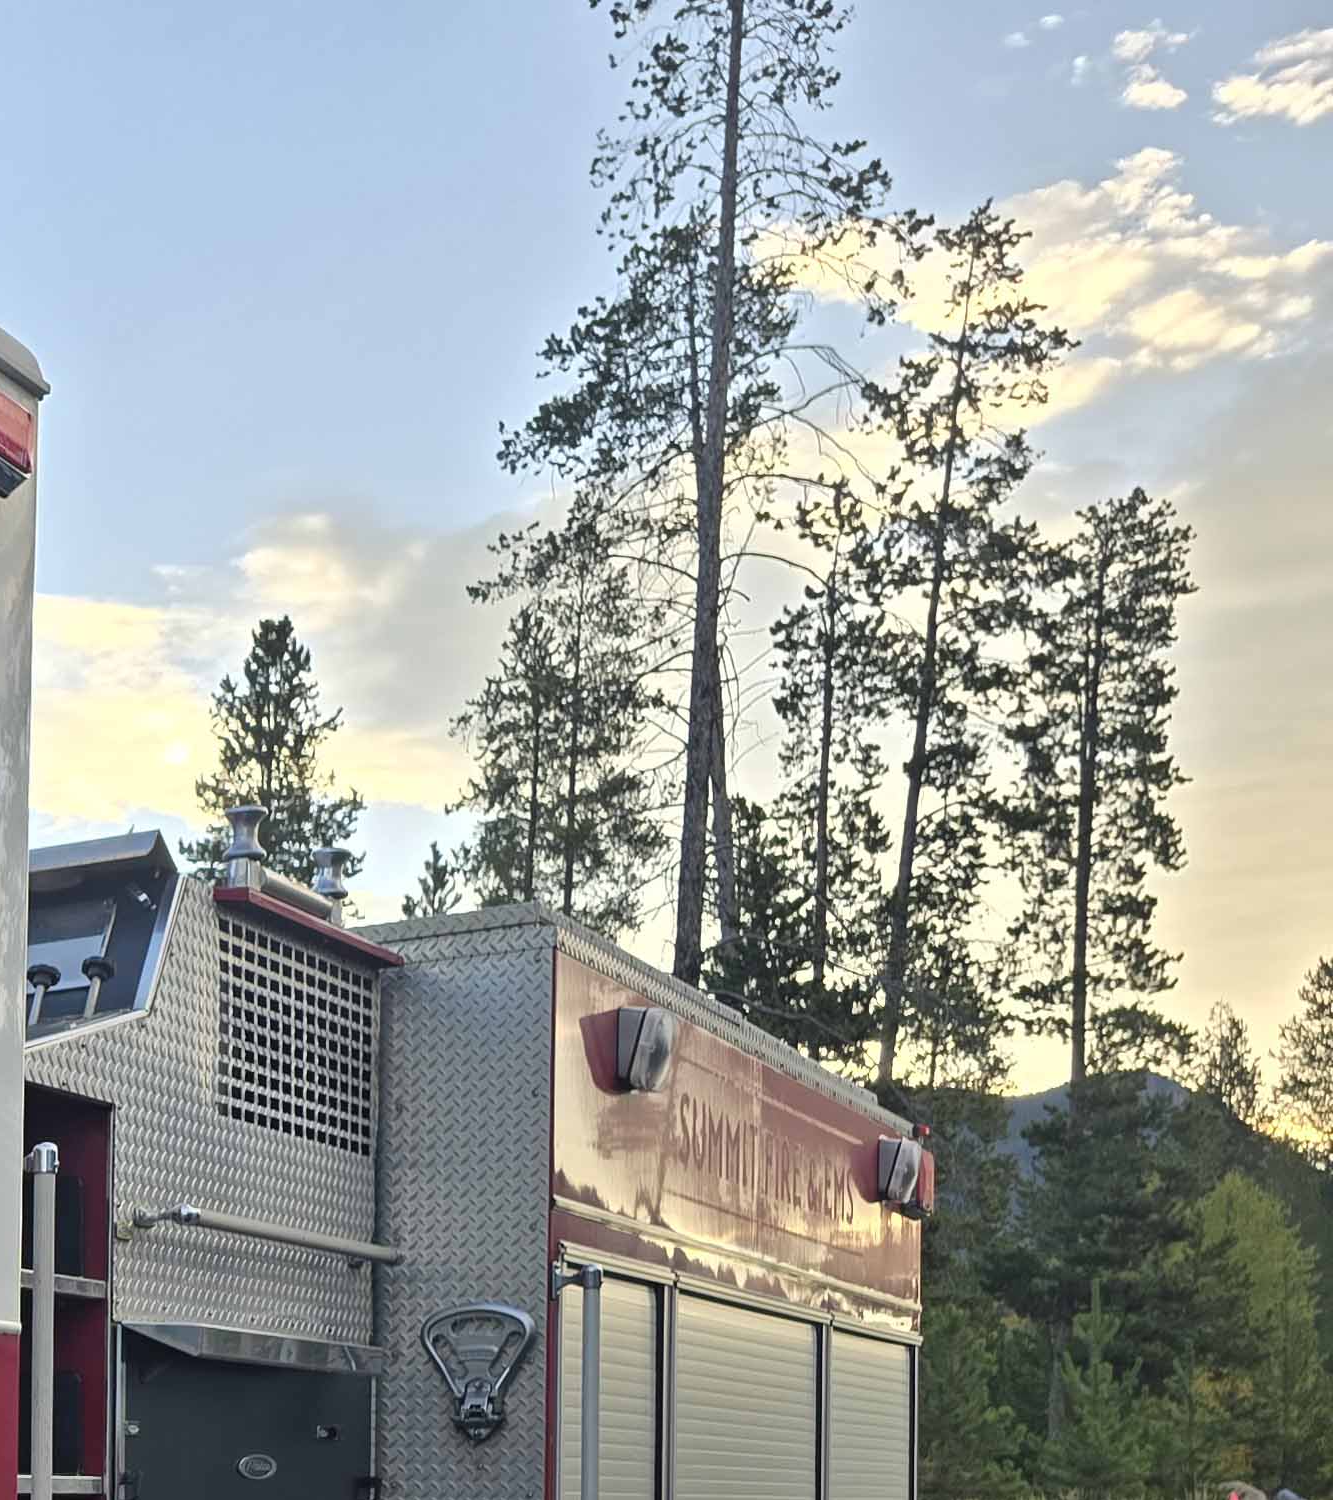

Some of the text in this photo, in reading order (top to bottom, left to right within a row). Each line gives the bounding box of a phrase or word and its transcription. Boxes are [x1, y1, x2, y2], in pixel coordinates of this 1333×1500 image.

[680, 1092, 758, 1201] SUMMIT
[764, 1131, 801, 1210] FIRE
[823, 1157, 854, 1225] EMS
